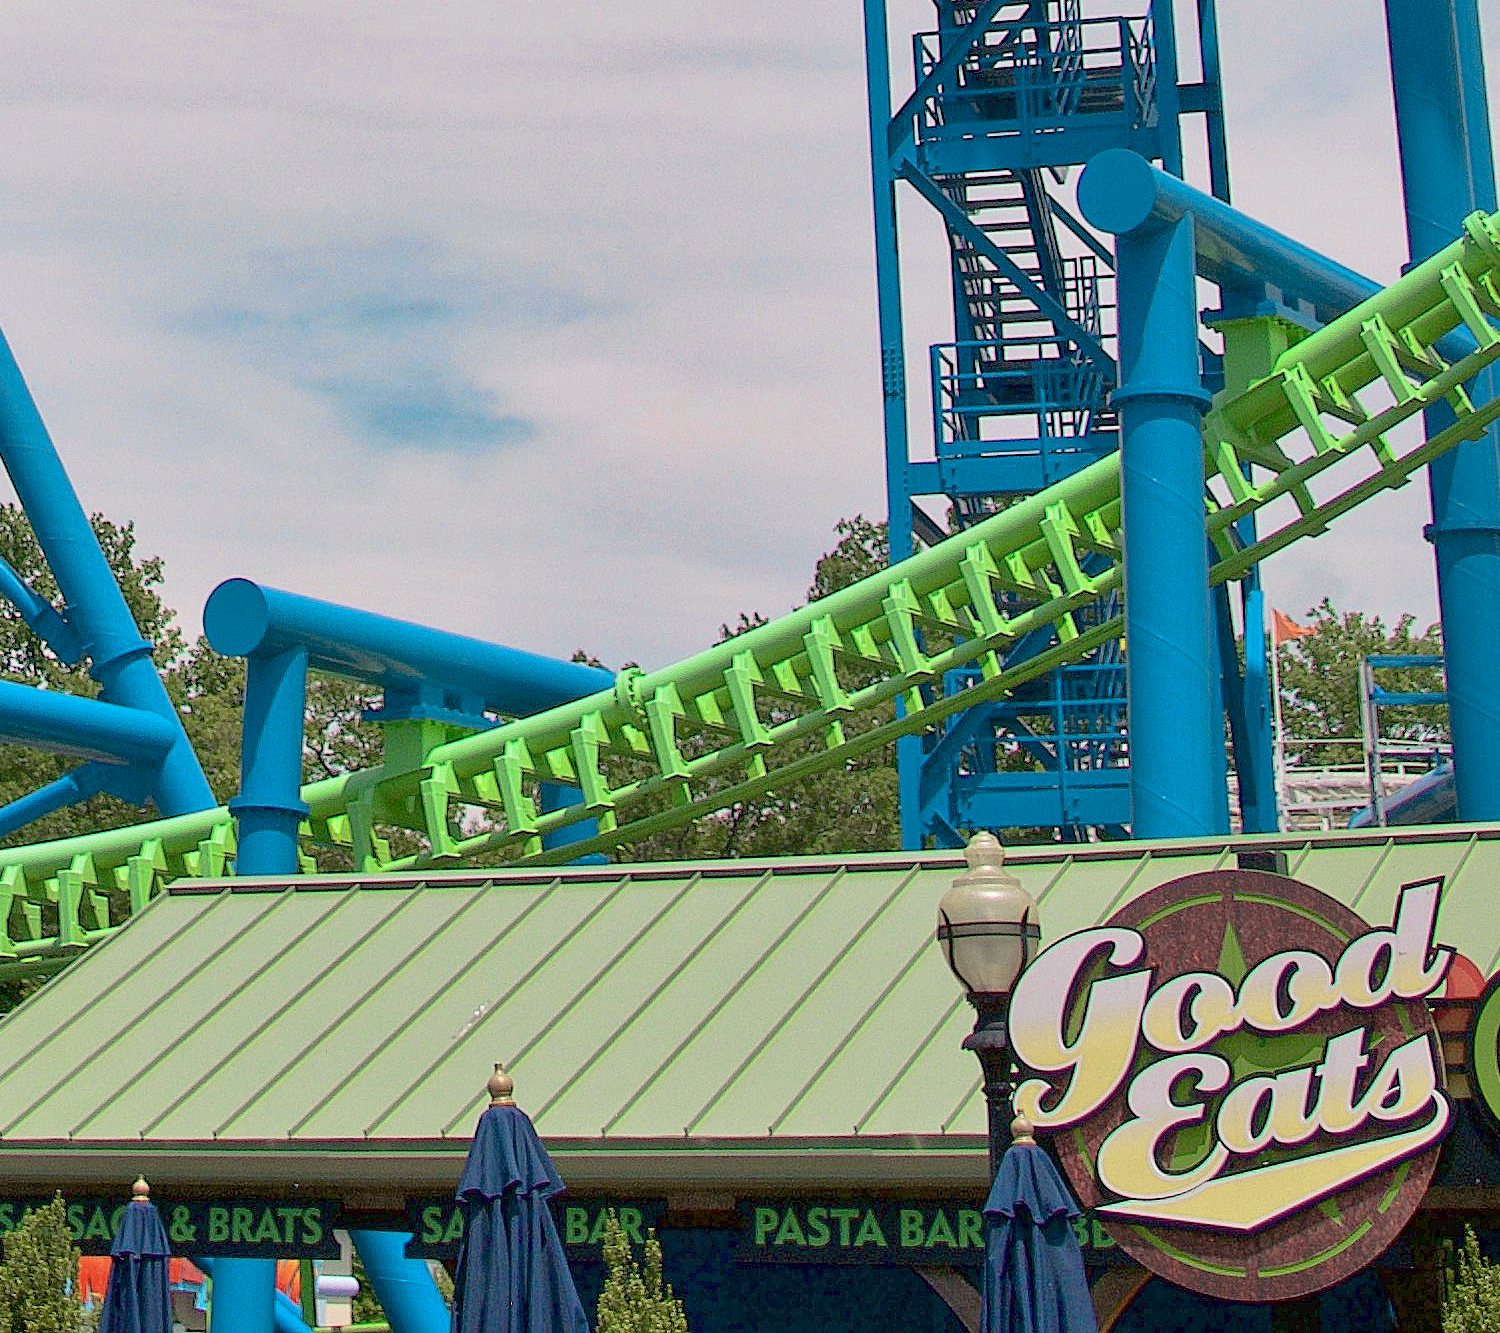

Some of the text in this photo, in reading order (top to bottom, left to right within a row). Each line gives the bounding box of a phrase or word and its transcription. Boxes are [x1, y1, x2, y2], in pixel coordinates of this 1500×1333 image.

[1009, 877, 1457, 1129] Good
[1096, 1027, 1442, 1201] Eats
[171, 1205, 196, 1242] &
[209, 1206, 321, 1244] BRATS
[755, 1207, 985, 1249] PASTA BAR
